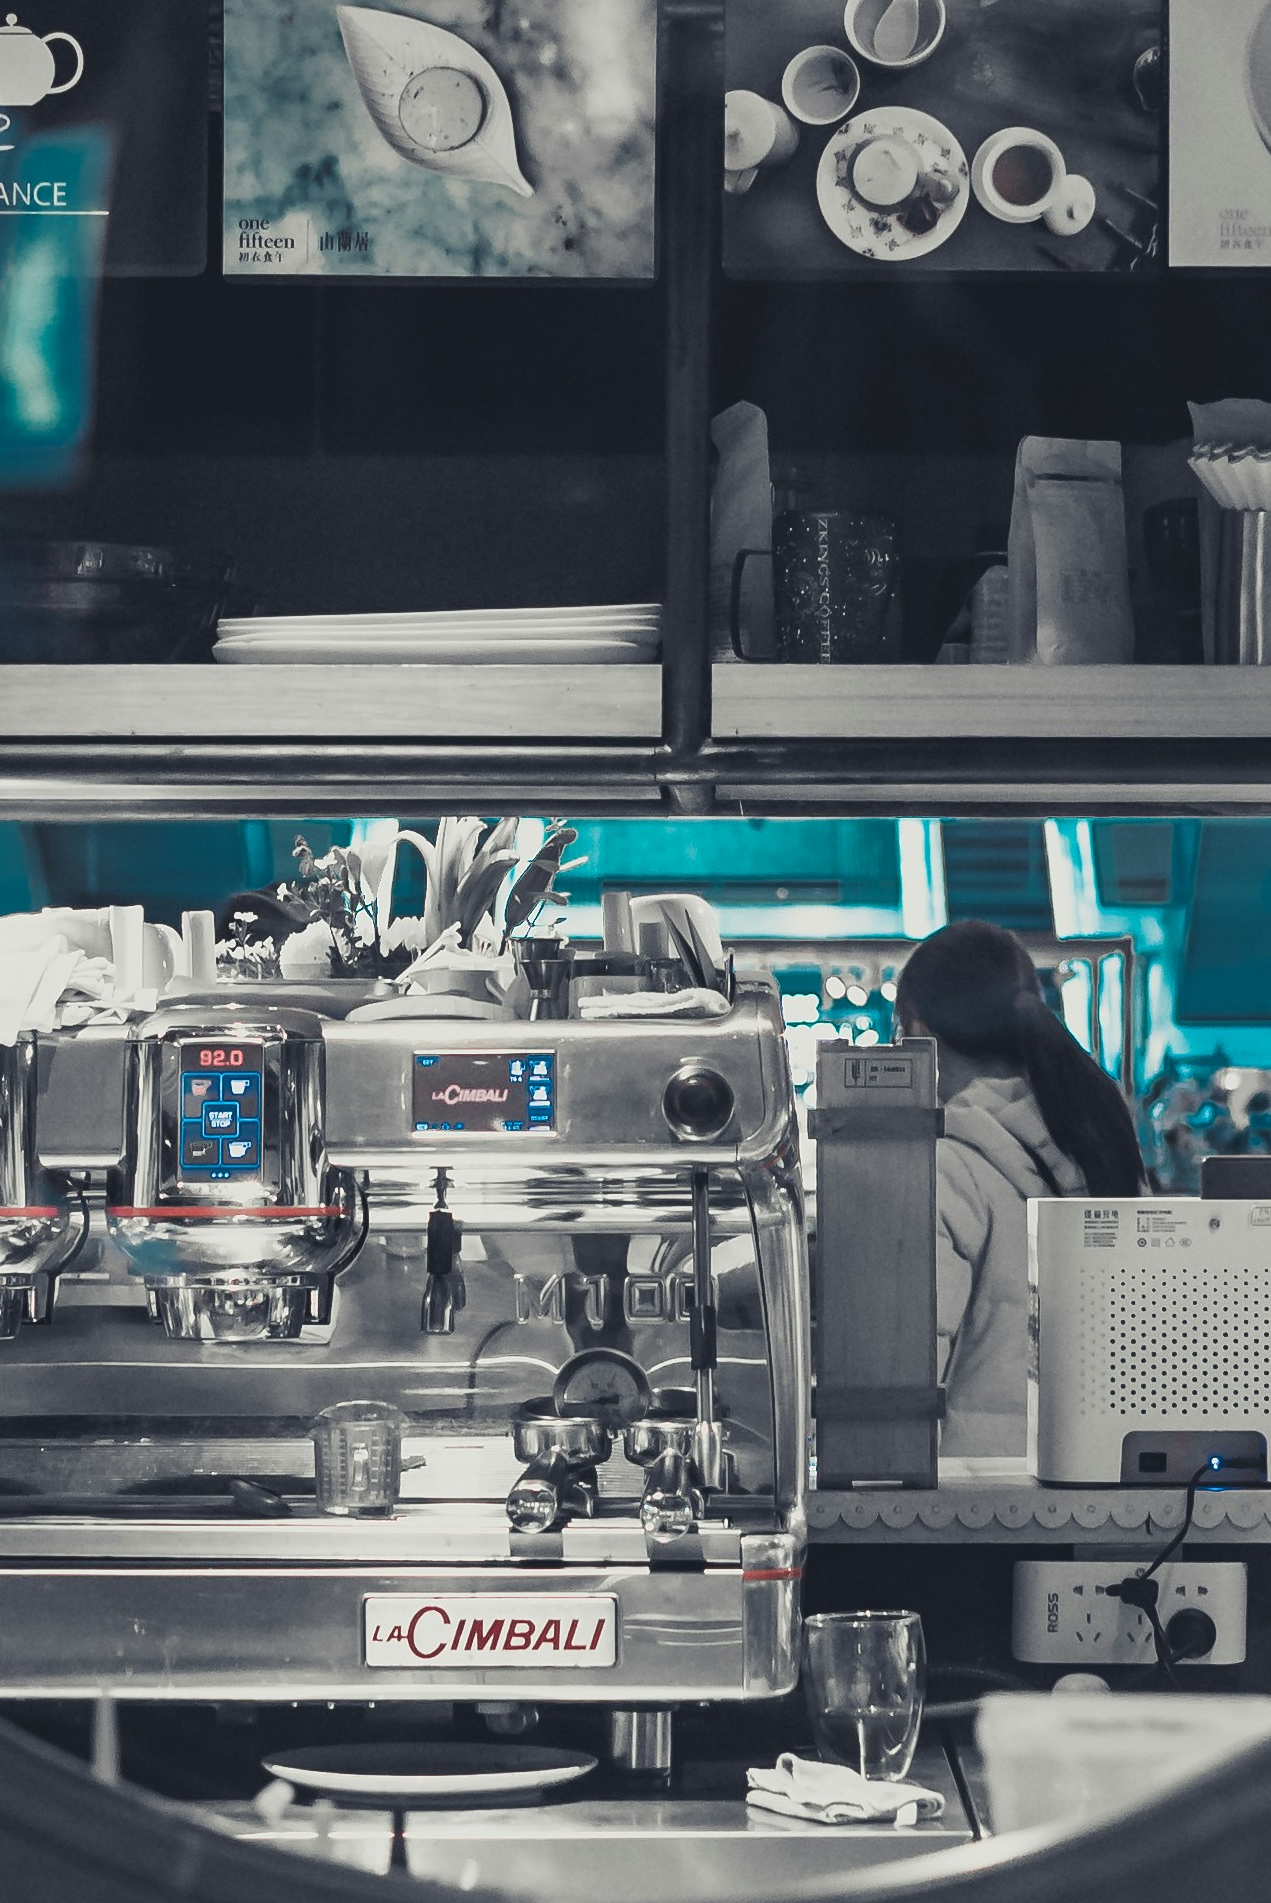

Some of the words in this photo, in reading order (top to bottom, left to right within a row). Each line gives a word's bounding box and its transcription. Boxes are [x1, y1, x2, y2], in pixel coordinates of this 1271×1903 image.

[1219, 208, 1249, 220] one
[238, 218, 270, 230] one
[238, 231, 295, 249] fifteen
[200, 1050, 244, 1066] 92.0
[431, 1092, 445, 1101] LA
[444, 1084, 508, 1105] CIMBALI
[209, 1111, 232, 1120] START
[211, 1119, 231, 1128] STOP
[1047, 1592, 1059, 1634] ROSS
[372, 1625, 403, 1642] LA
[407, 1606, 606, 1659] CIMBALI
